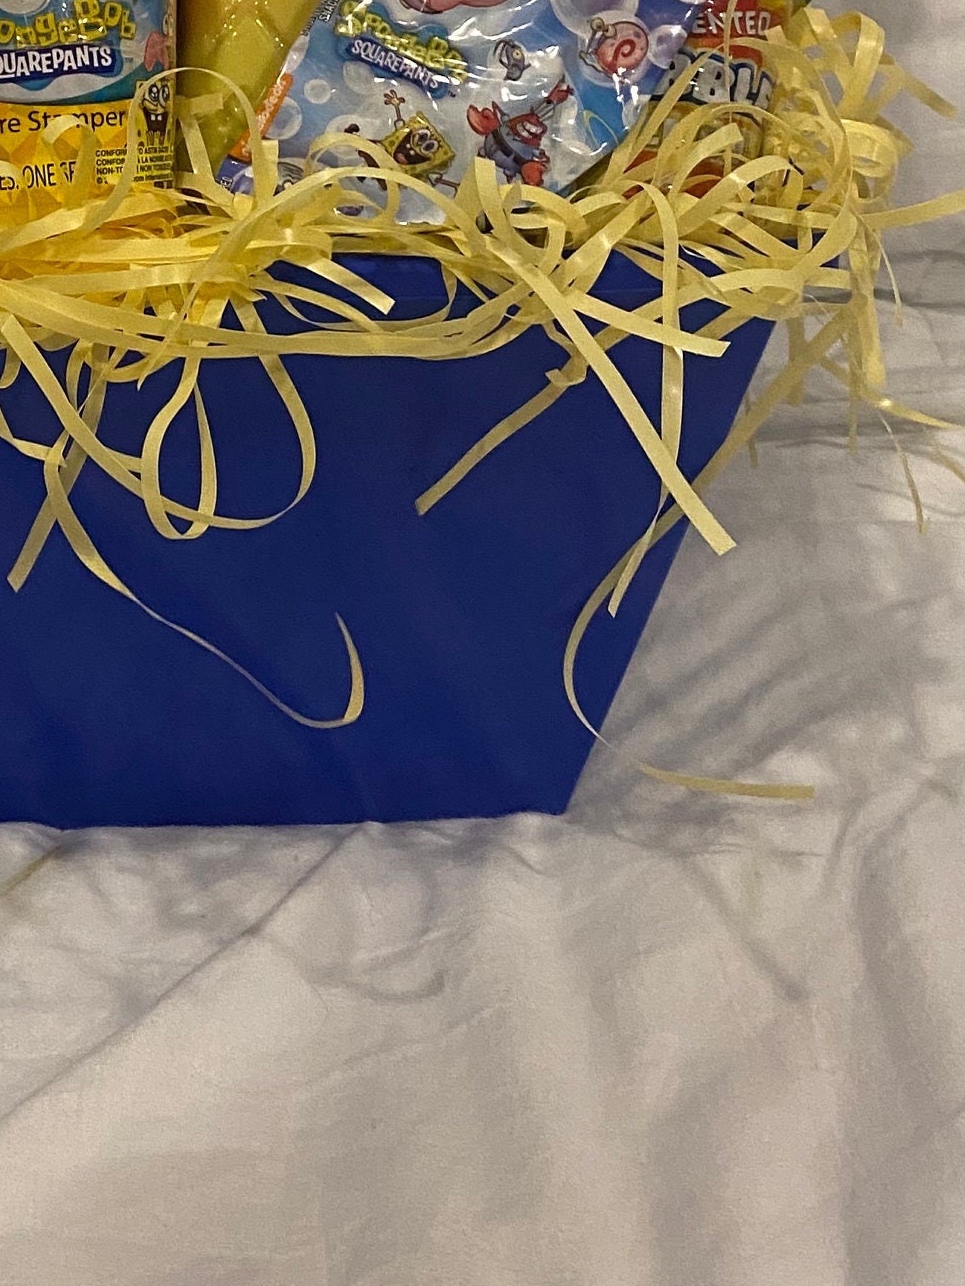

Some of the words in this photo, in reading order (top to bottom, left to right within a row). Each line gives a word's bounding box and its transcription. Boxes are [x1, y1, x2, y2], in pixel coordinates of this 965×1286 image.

[351, 39, 439, 89] SQUAREPANTS
[28, 110, 126, 132] Stmper
[22, 162, 57, 190] ONE
